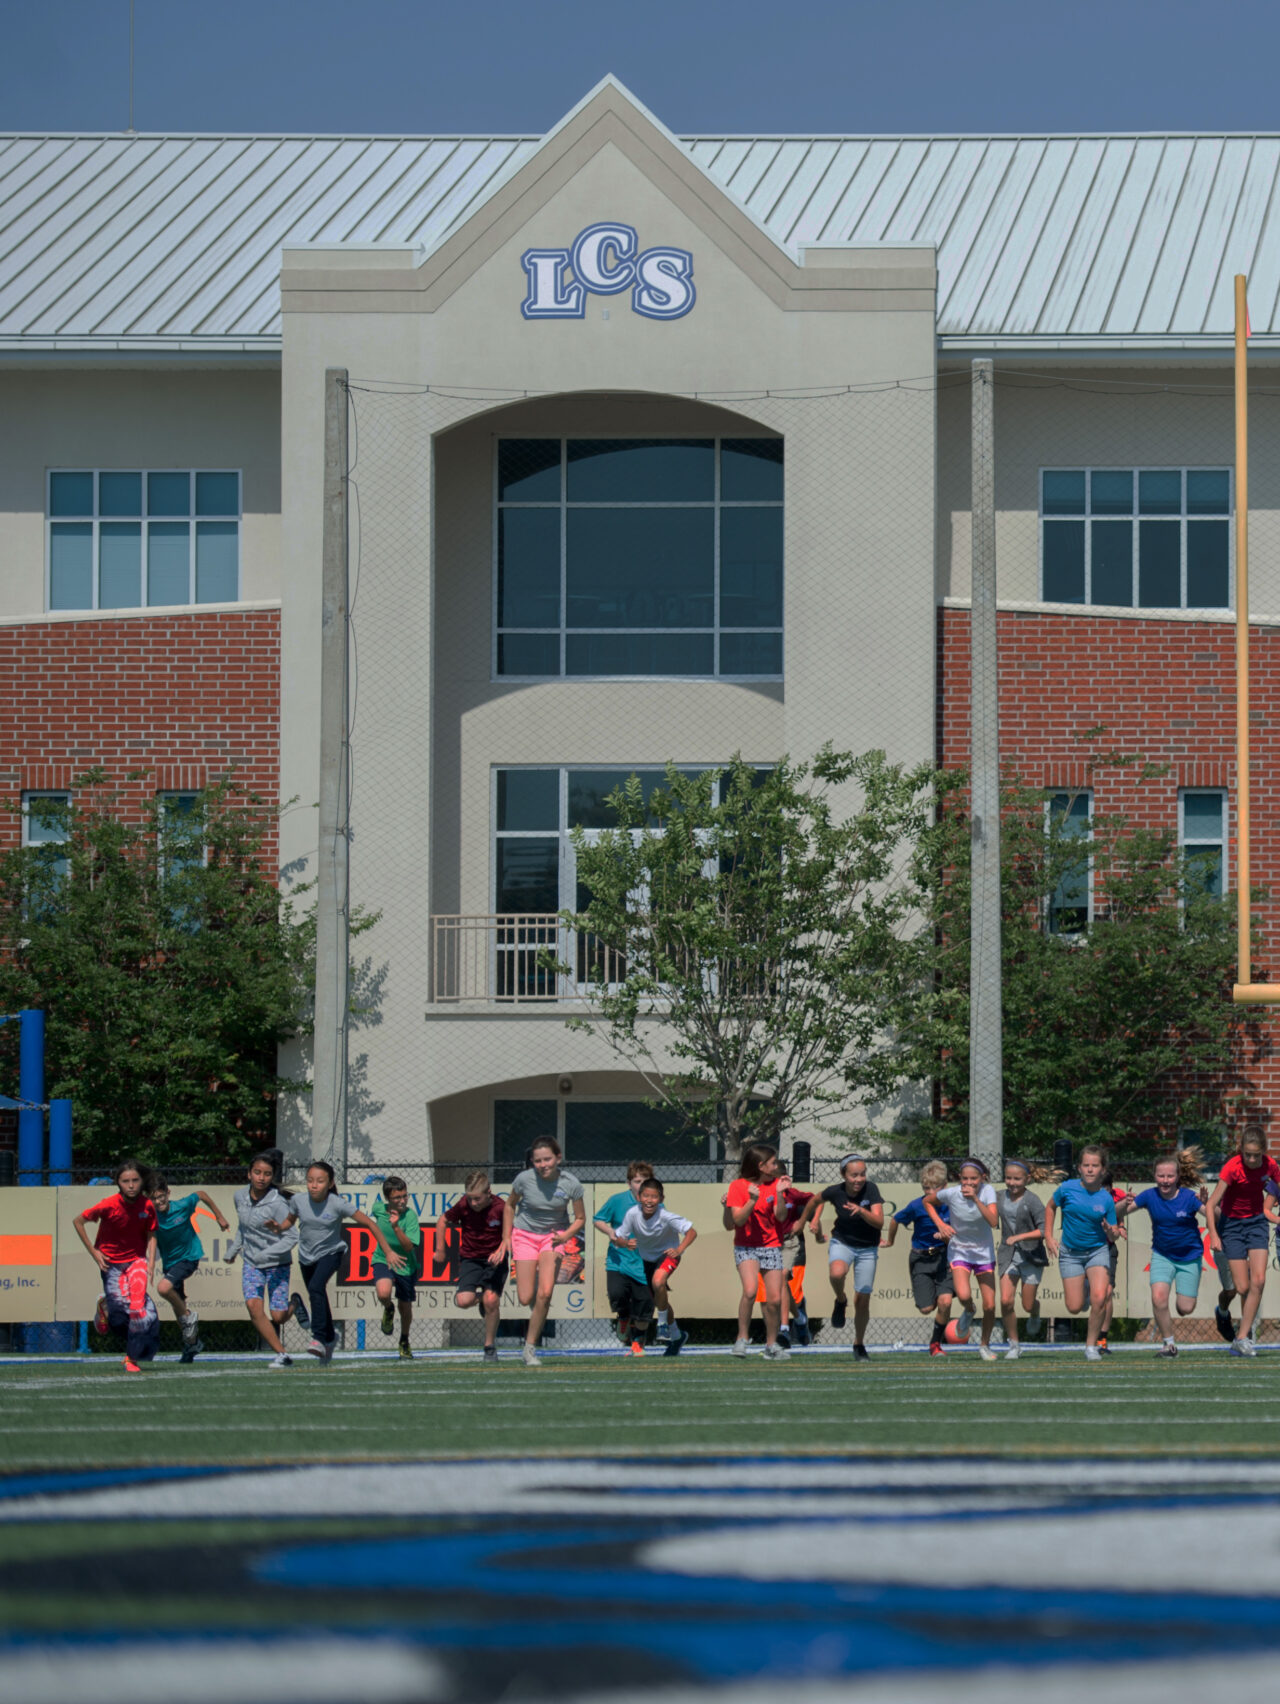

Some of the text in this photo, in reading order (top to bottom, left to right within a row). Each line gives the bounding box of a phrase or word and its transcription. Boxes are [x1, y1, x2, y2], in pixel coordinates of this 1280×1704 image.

[520, 221, 697, 321] LCS
[17, 1276, 40, 1288] Inc.
[334, 1290, 366, 1309] IT'S
